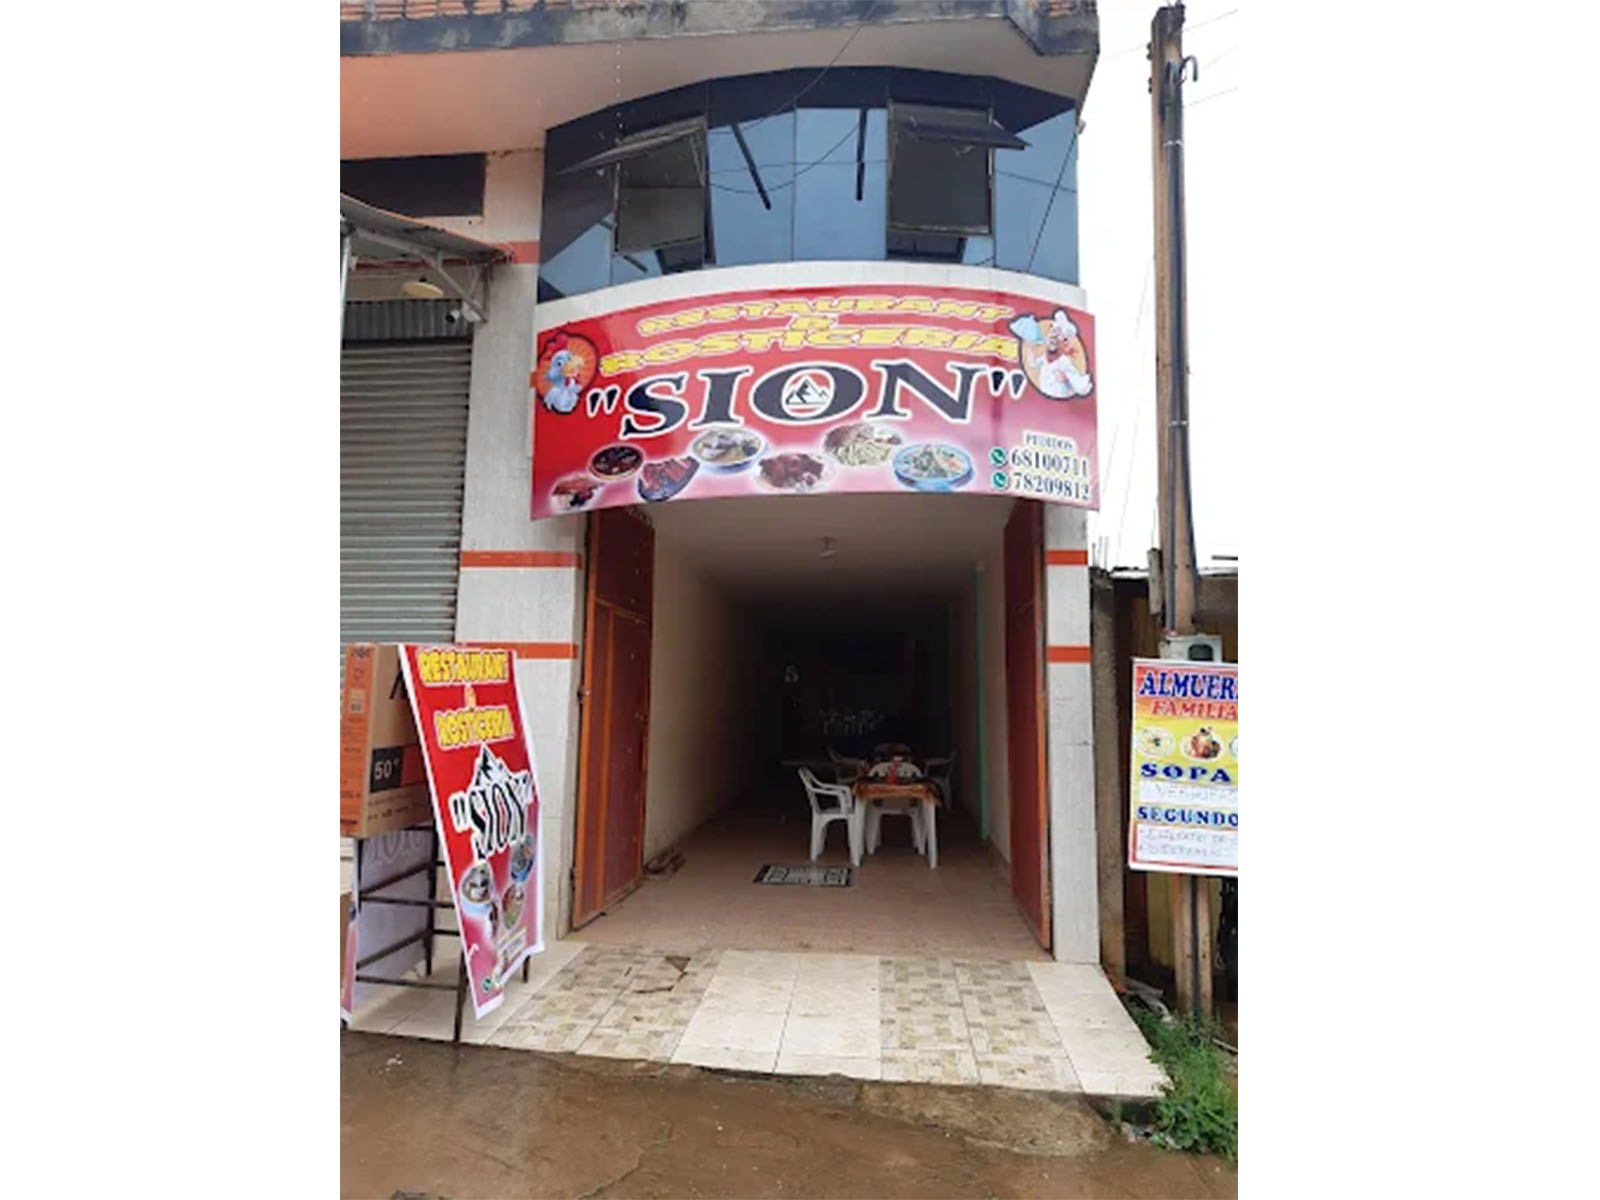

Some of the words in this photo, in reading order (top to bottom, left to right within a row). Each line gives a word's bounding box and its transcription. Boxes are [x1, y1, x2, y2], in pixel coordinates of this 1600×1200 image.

[637, 297, 1013, 336] RESTAURANT
[1025, 433, 1073, 451] PEDIDOS
[1011, 448, 1087, 477] 68100711
[1013, 471, 1089, 501] 78209812
[418, 650, 508, 684] RESTAURANT
[1139, 671, 1238, 700] ALMUER
[435, 708, 513, 749] ROSTICERIA
[1140, 763, 1231, 783] SOPA
